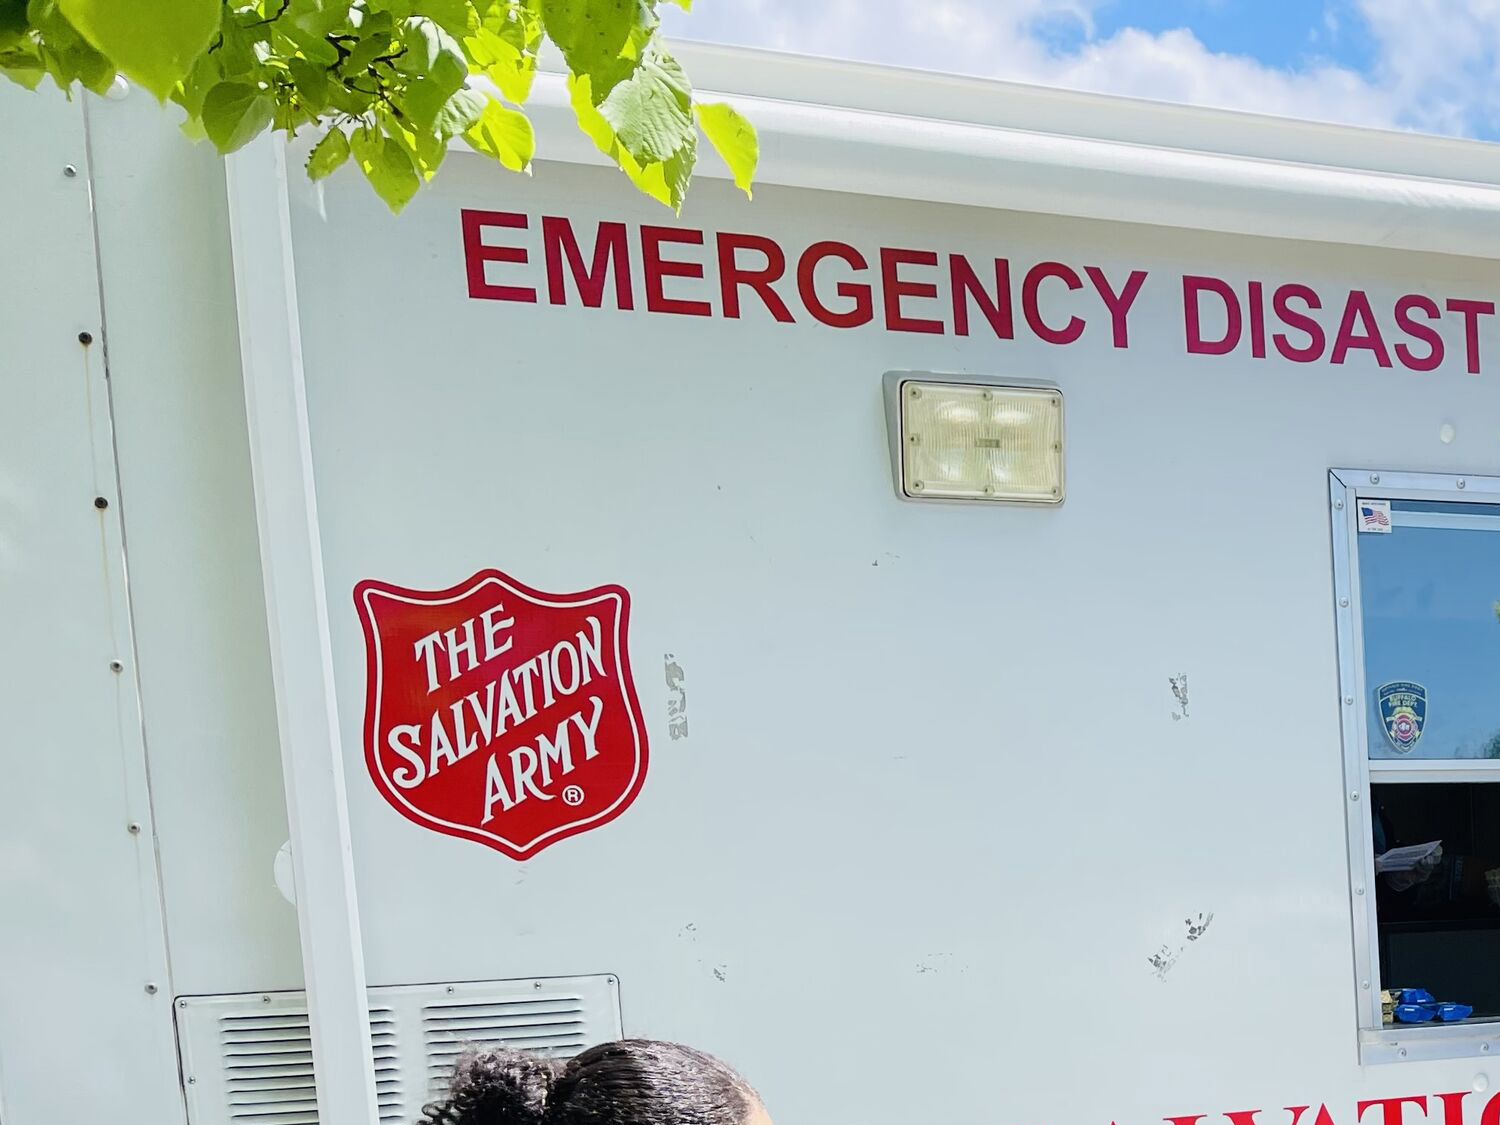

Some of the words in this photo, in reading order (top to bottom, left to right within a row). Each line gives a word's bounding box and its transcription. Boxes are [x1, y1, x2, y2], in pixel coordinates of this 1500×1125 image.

[460, 208, 1148, 349] EMERGENCY
[387, 615, 608, 789] SALVATION
[413, 603, 515, 696] THE
[480, 695, 604, 826] ARMY
